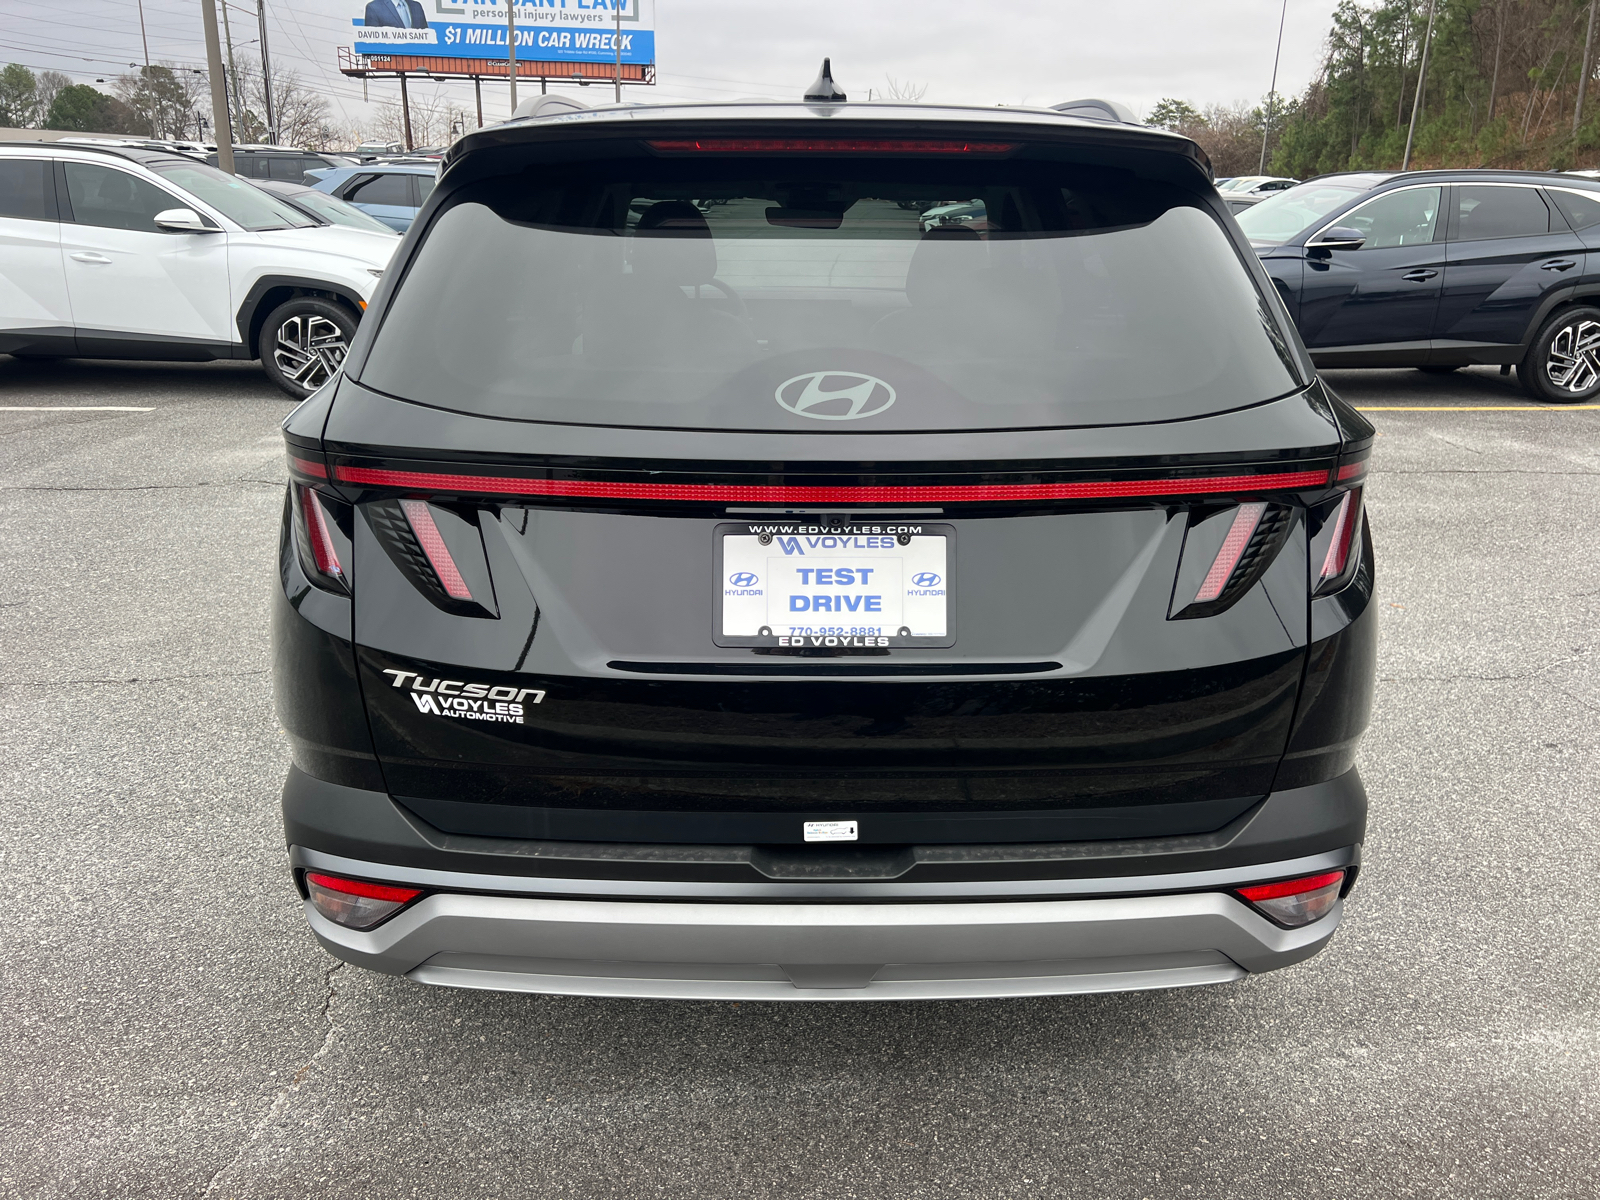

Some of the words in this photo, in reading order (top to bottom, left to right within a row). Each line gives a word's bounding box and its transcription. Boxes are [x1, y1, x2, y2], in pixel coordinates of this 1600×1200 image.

[524, 9, 556, 22] injury
[560, 10, 602, 23] lawyers
[444, 26, 461, 44] $1
[466, 29, 534, 46] MILLION
[538, 31, 571, 47] CAR
[575, 33, 633, 50] WRECK
[749, 526, 922, 534] WWW.EDVOYLES.COM
[805, 537, 894, 548] VOYLES
[796, 568, 874, 585] TEST
[790, 595, 881, 612] DRIVE
[789, 627, 882, 636] 770-952-8881
[779, 637, 804, 646] ED
[811, 637, 889, 646] VOYLES
[438, 696, 523, 715] VOYLES
[442, 709, 524, 724] AUTOMOTIVE
